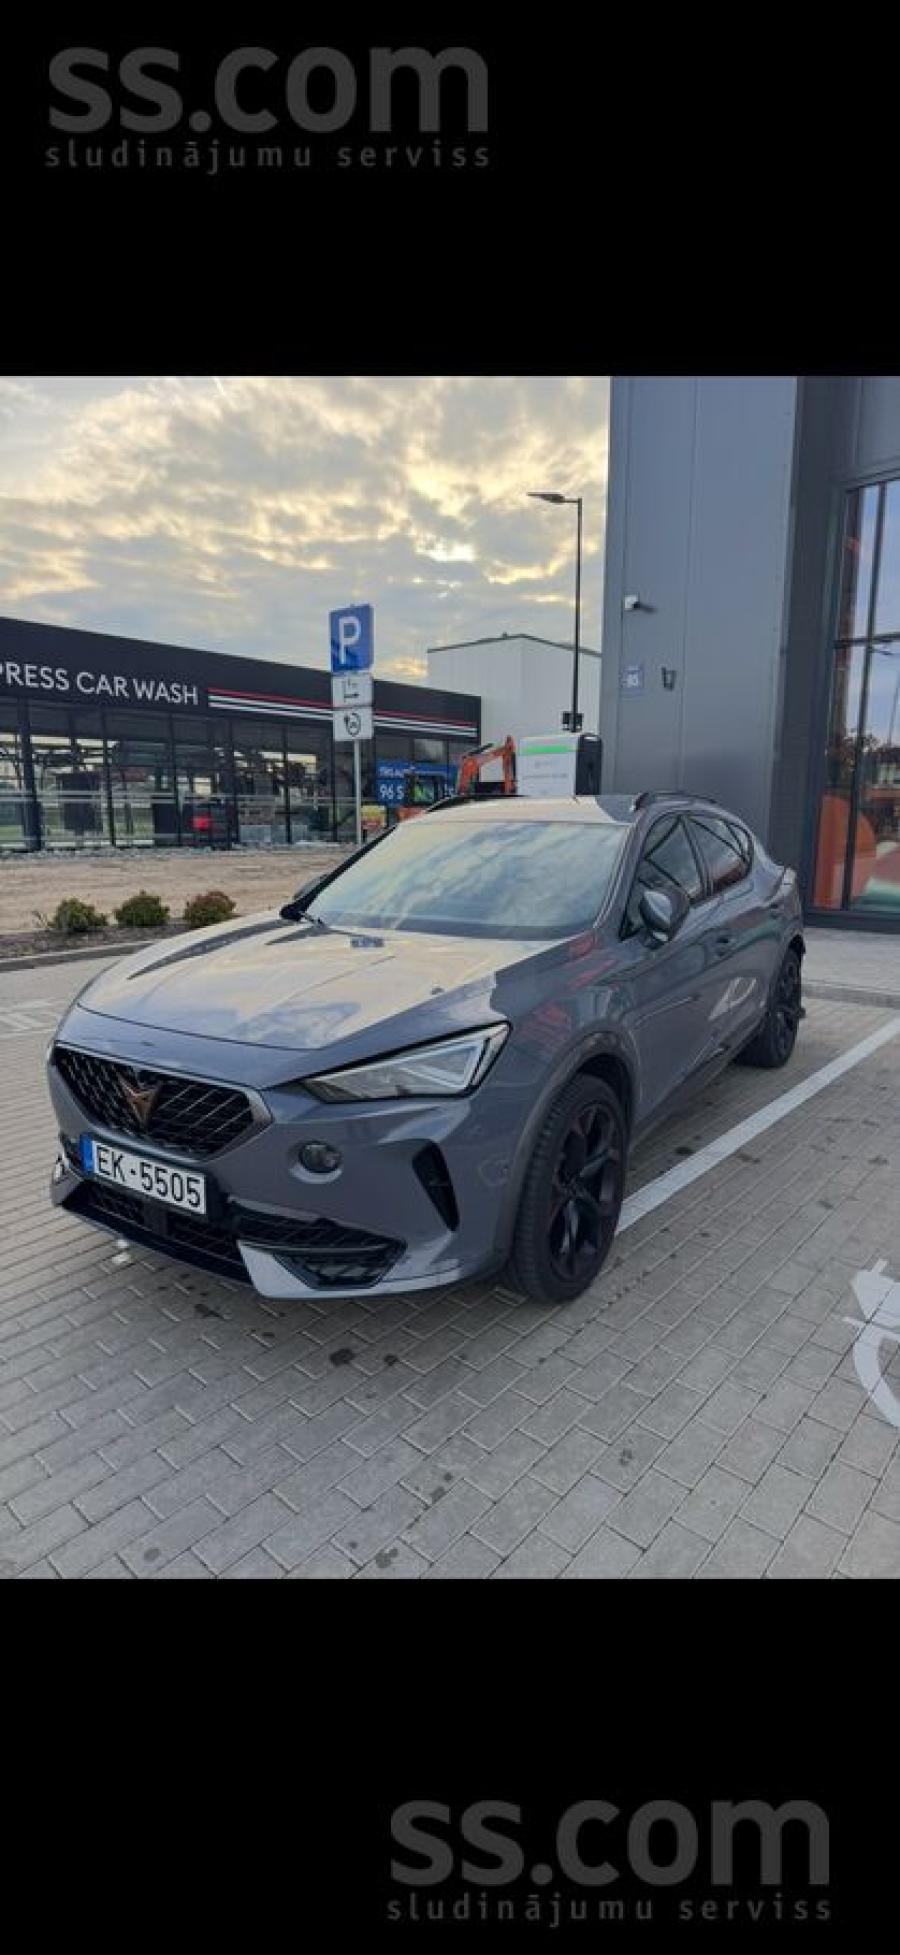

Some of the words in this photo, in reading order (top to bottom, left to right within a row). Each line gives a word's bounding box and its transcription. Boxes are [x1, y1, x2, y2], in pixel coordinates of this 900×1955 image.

[338, 616, 361, 665] P
[76, 672, 129, 698] CAR
[133, 678, 199, 705] WASH
[97, 1144, 201, 1208] EK-5505
